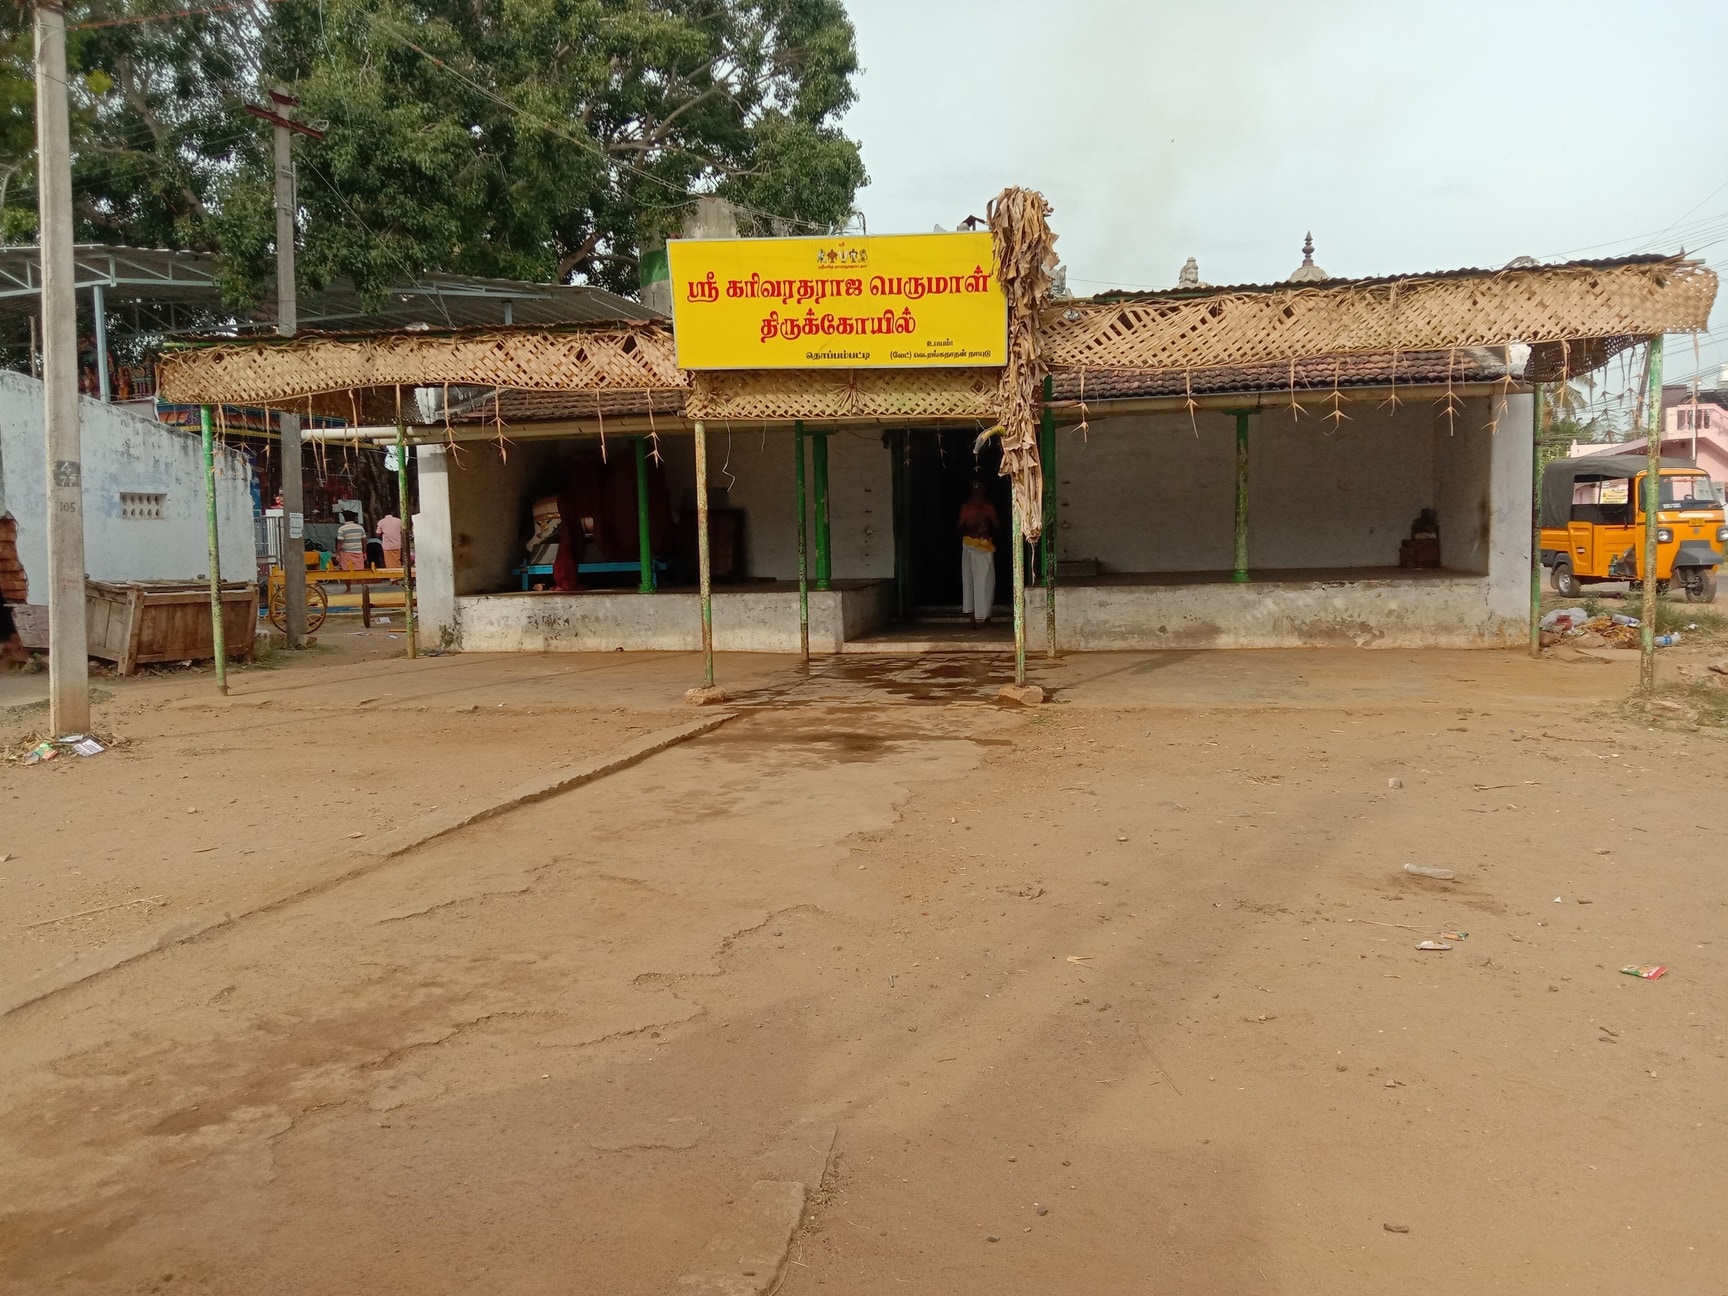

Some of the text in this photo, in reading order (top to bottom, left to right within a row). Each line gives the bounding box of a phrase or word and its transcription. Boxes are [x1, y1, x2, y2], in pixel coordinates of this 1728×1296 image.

[687, 264, 993, 305] ஸ்ரீ கரிவரதராஜ பெருமாள்
[760, 306, 916, 343] திருக்கோயில்
[805, 349, 871, 361] தொப்பம்பட்டி
[889, 350, 912, 360] (லேட்)
[968, 349, 991, 359] நாயுடு
